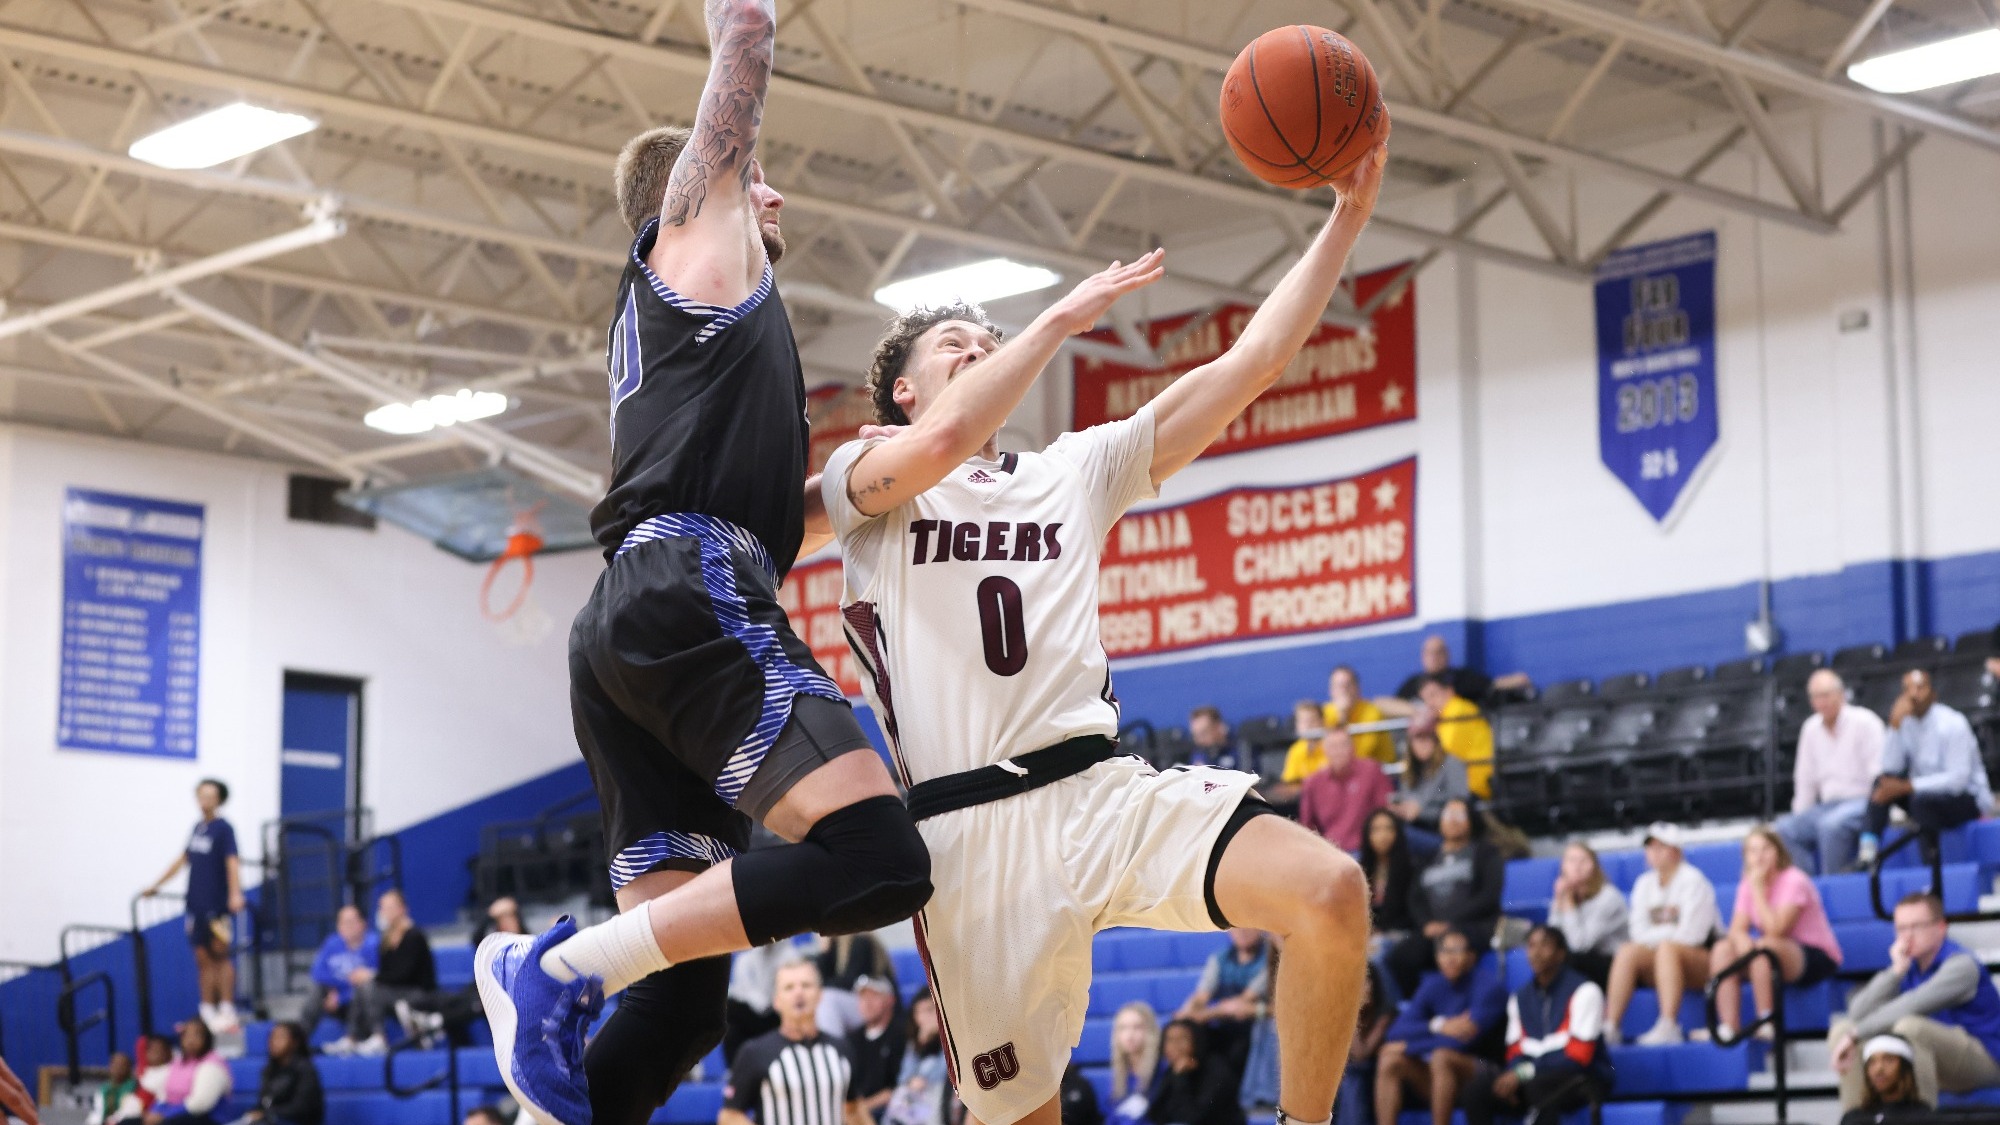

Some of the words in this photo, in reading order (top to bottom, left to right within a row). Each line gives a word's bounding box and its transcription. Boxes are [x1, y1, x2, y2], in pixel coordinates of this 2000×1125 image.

[1273, 326, 1378, 388] MPIONS
[1615, 371, 1699, 434] 2013
[909, 518, 1064, 565] TIGERS
[1118, 509, 1193, 556] NAIA
[1227, 481, 1359, 537] SOCCER
[1099, 554, 1207, 605] ATIONAL
[1233, 520, 1406, 585] CHAMPIONS
[976, 575, 1028, 677] 0
[1100, 608, 1152, 652] 999
[1249, 573, 1388, 632] PROGRAM
[972, 1042, 1019, 1091] CU
